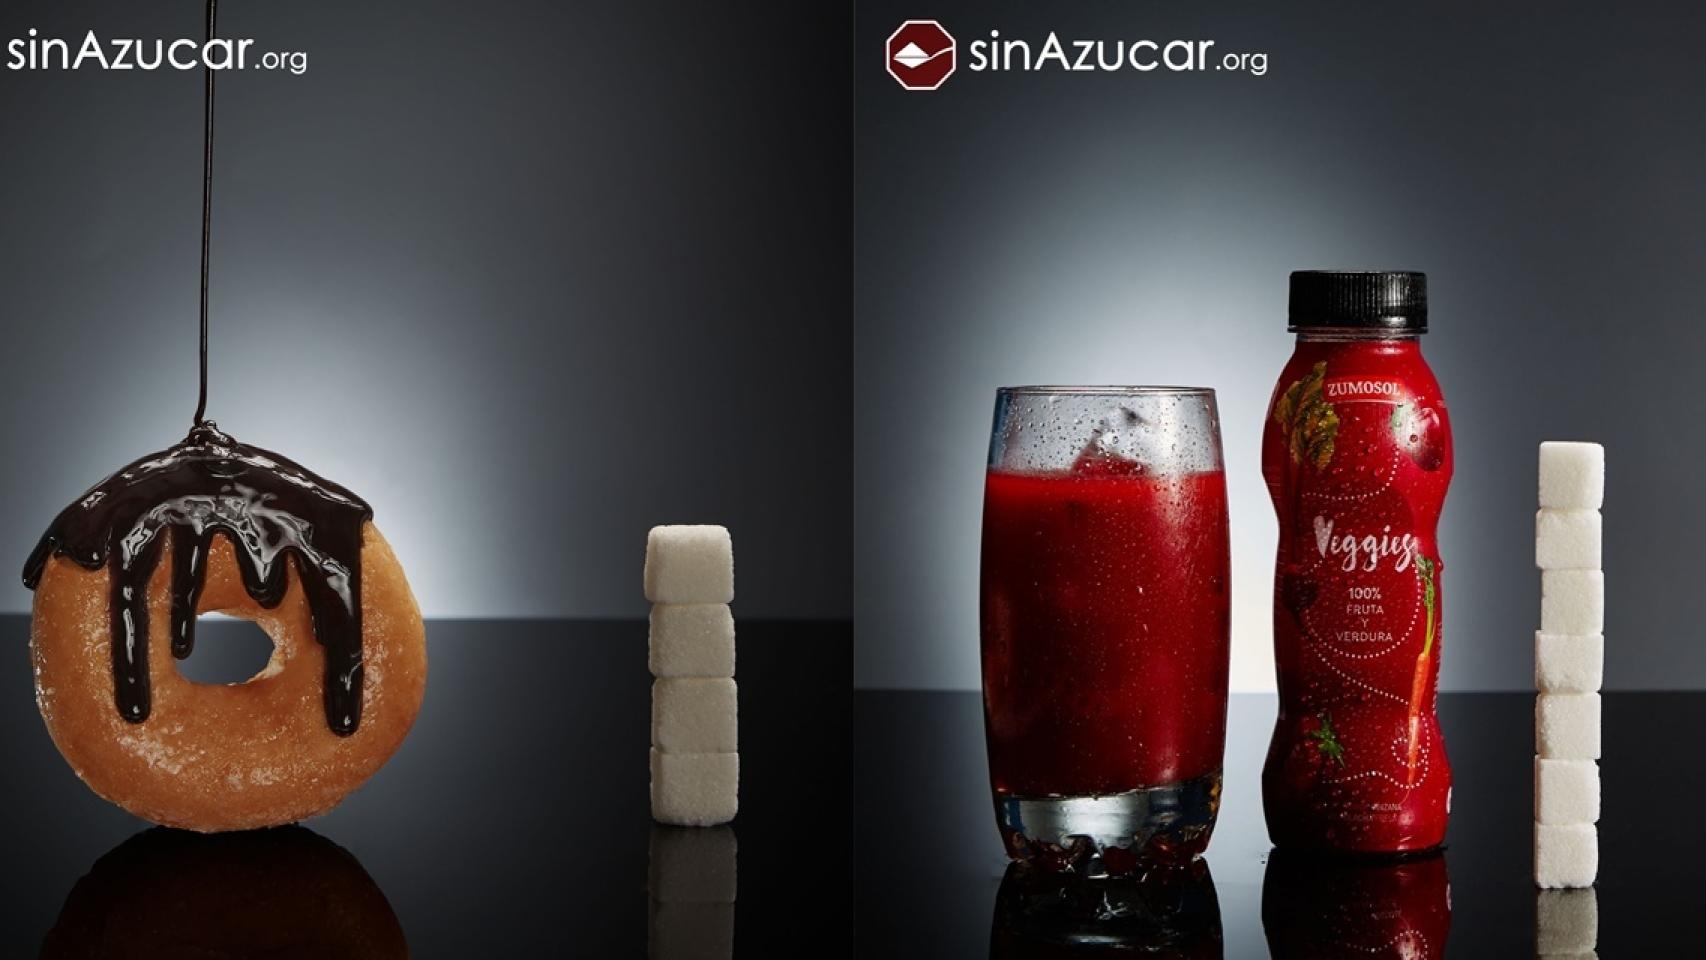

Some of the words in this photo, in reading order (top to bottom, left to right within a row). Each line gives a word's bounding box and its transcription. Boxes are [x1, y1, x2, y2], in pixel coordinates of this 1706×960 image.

[1327, 380, 1402, 396] ZUMOSOL
[1313, 515, 1419, 572] Veggies
[1349, 587, 1381, 600] 100%
[1346, 605, 1384, 616] FRUTA
[1361, 618, 1368, 628] Y
[1336, 632, 1393, 642] VERDURA
